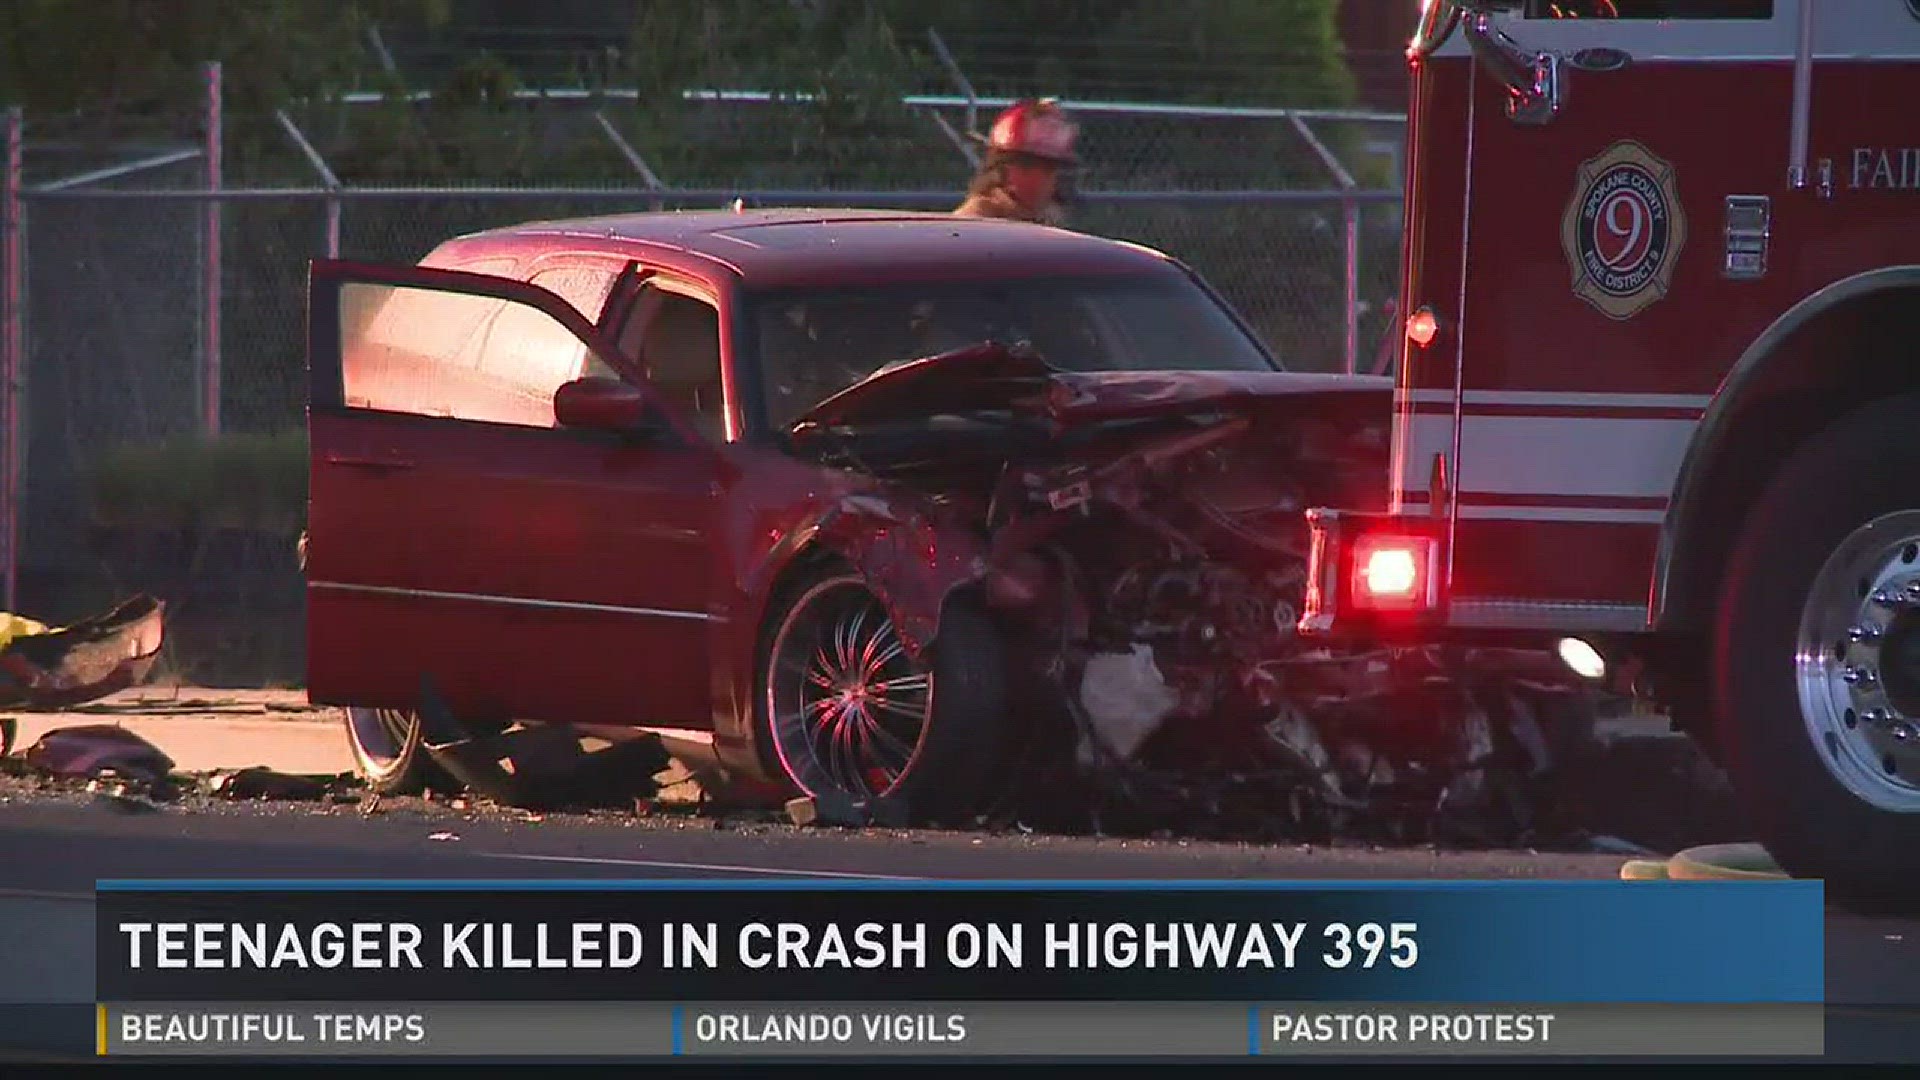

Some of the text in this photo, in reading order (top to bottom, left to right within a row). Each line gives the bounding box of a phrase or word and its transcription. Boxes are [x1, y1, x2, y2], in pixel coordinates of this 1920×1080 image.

[1585, 171, 1664, 219] SPOKANE COUNTY
[1605, 195, 1642, 266] 9
[1584, 250, 1603, 280] FIRE
[1605, 263, 1653, 289] DISTRICT
